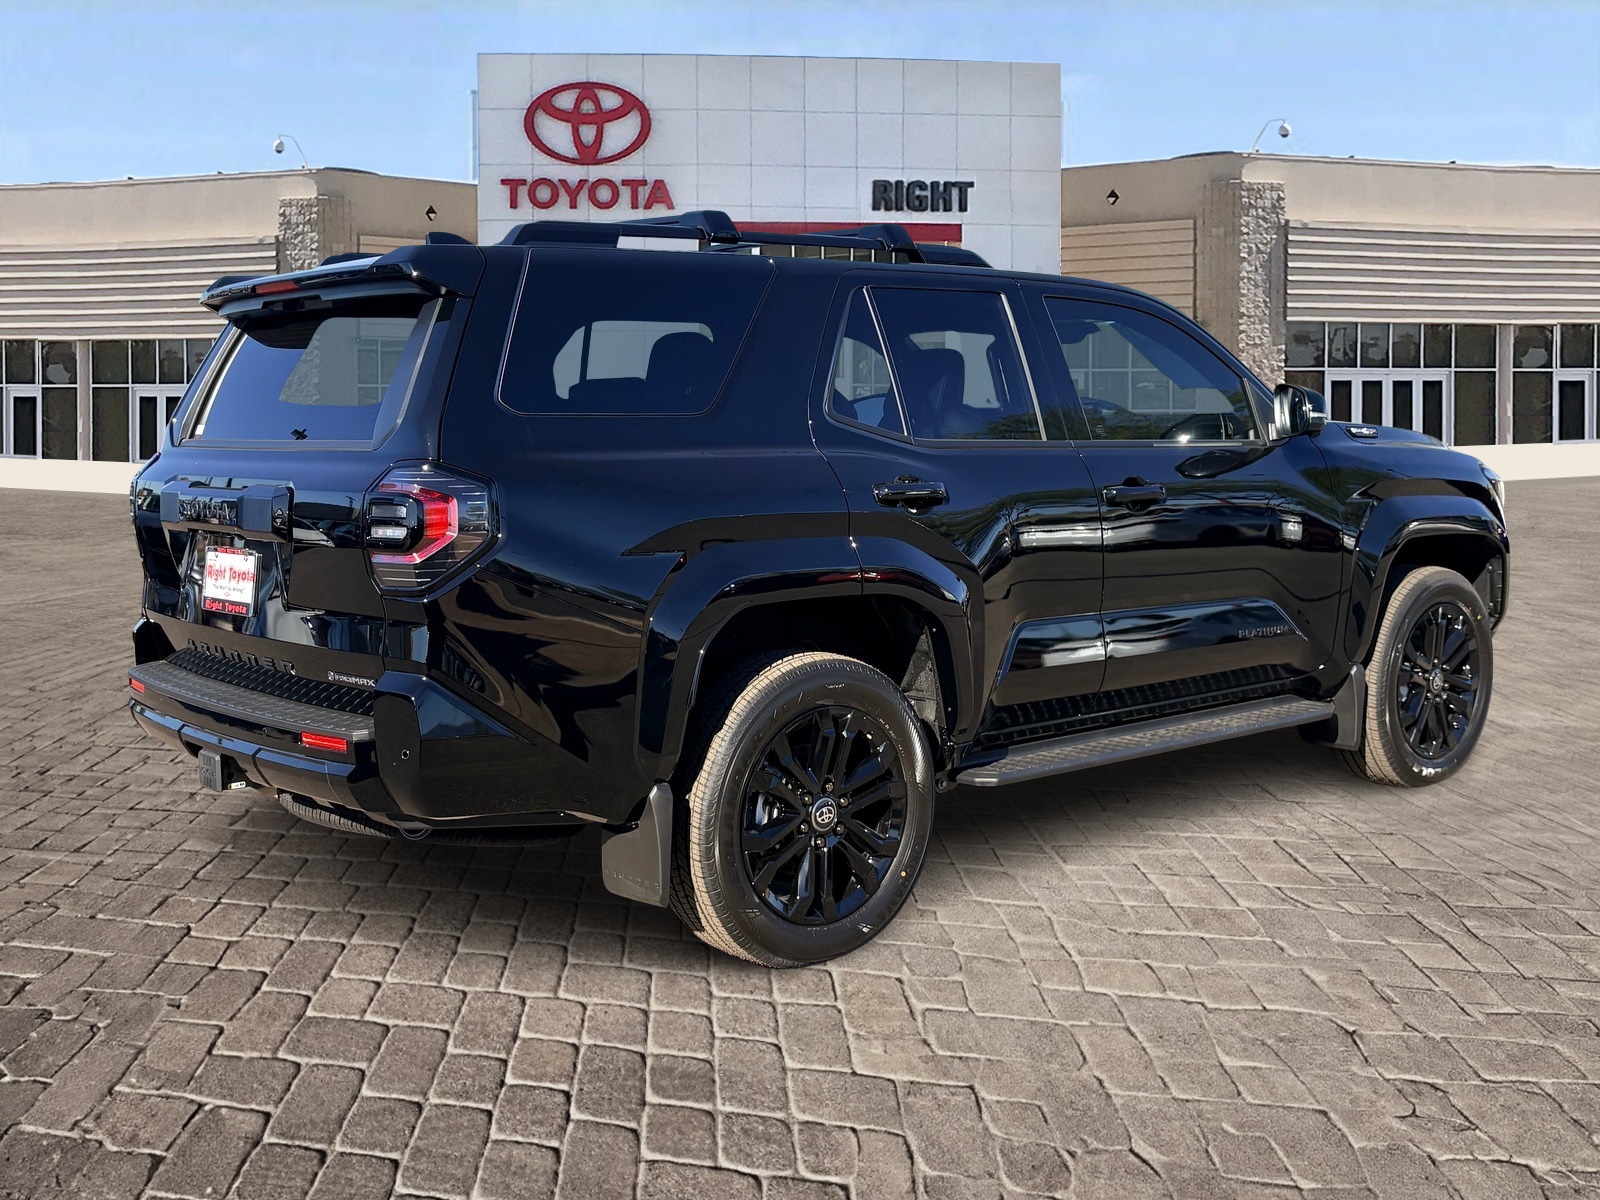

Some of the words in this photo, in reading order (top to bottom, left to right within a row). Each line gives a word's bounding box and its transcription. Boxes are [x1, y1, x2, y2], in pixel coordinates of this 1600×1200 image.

[500, 178, 675, 209] TOYOTA
[872, 179, 975, 212] RIGHT
[207, 564, 226, 582] Right
[228, 567, 255, 583] Toyota
[205, 598, 223, 610] Right
[224, 603, 247, 614] Toyota
[1238, 625, 1289, 639] PLATINUM
